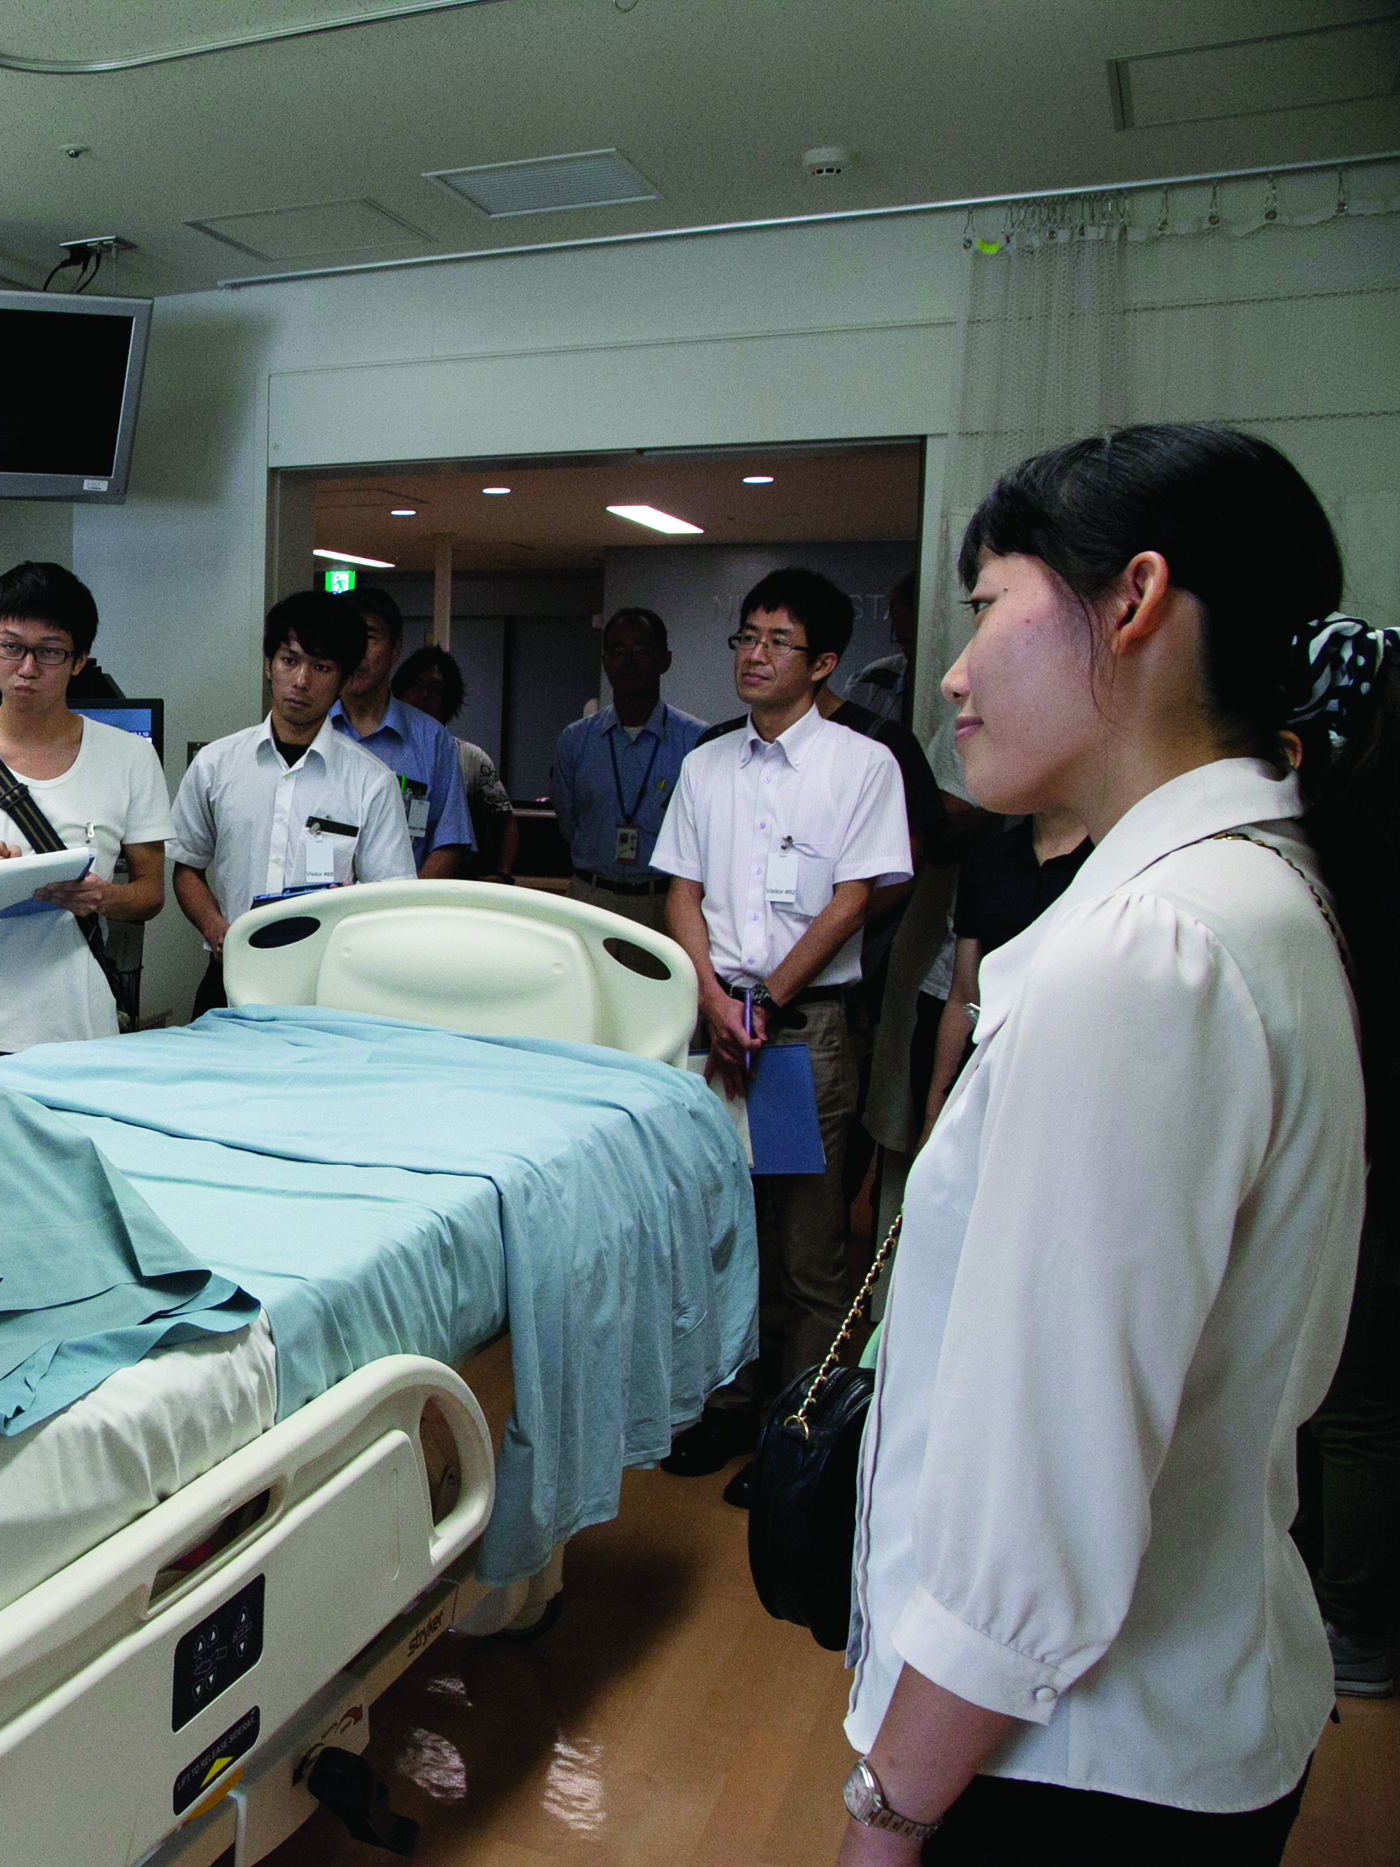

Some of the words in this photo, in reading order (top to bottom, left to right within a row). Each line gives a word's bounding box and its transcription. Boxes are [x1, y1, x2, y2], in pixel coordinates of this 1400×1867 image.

[407, 1610, 444, 1658] stryker
[177, 1773, 191, 1791] LIFT
[191, 1764, 200, 1777] TO
[200, 1738, 228, 1770] RELEASE
[228, 1716, 255, 1743] SIDERAIL
